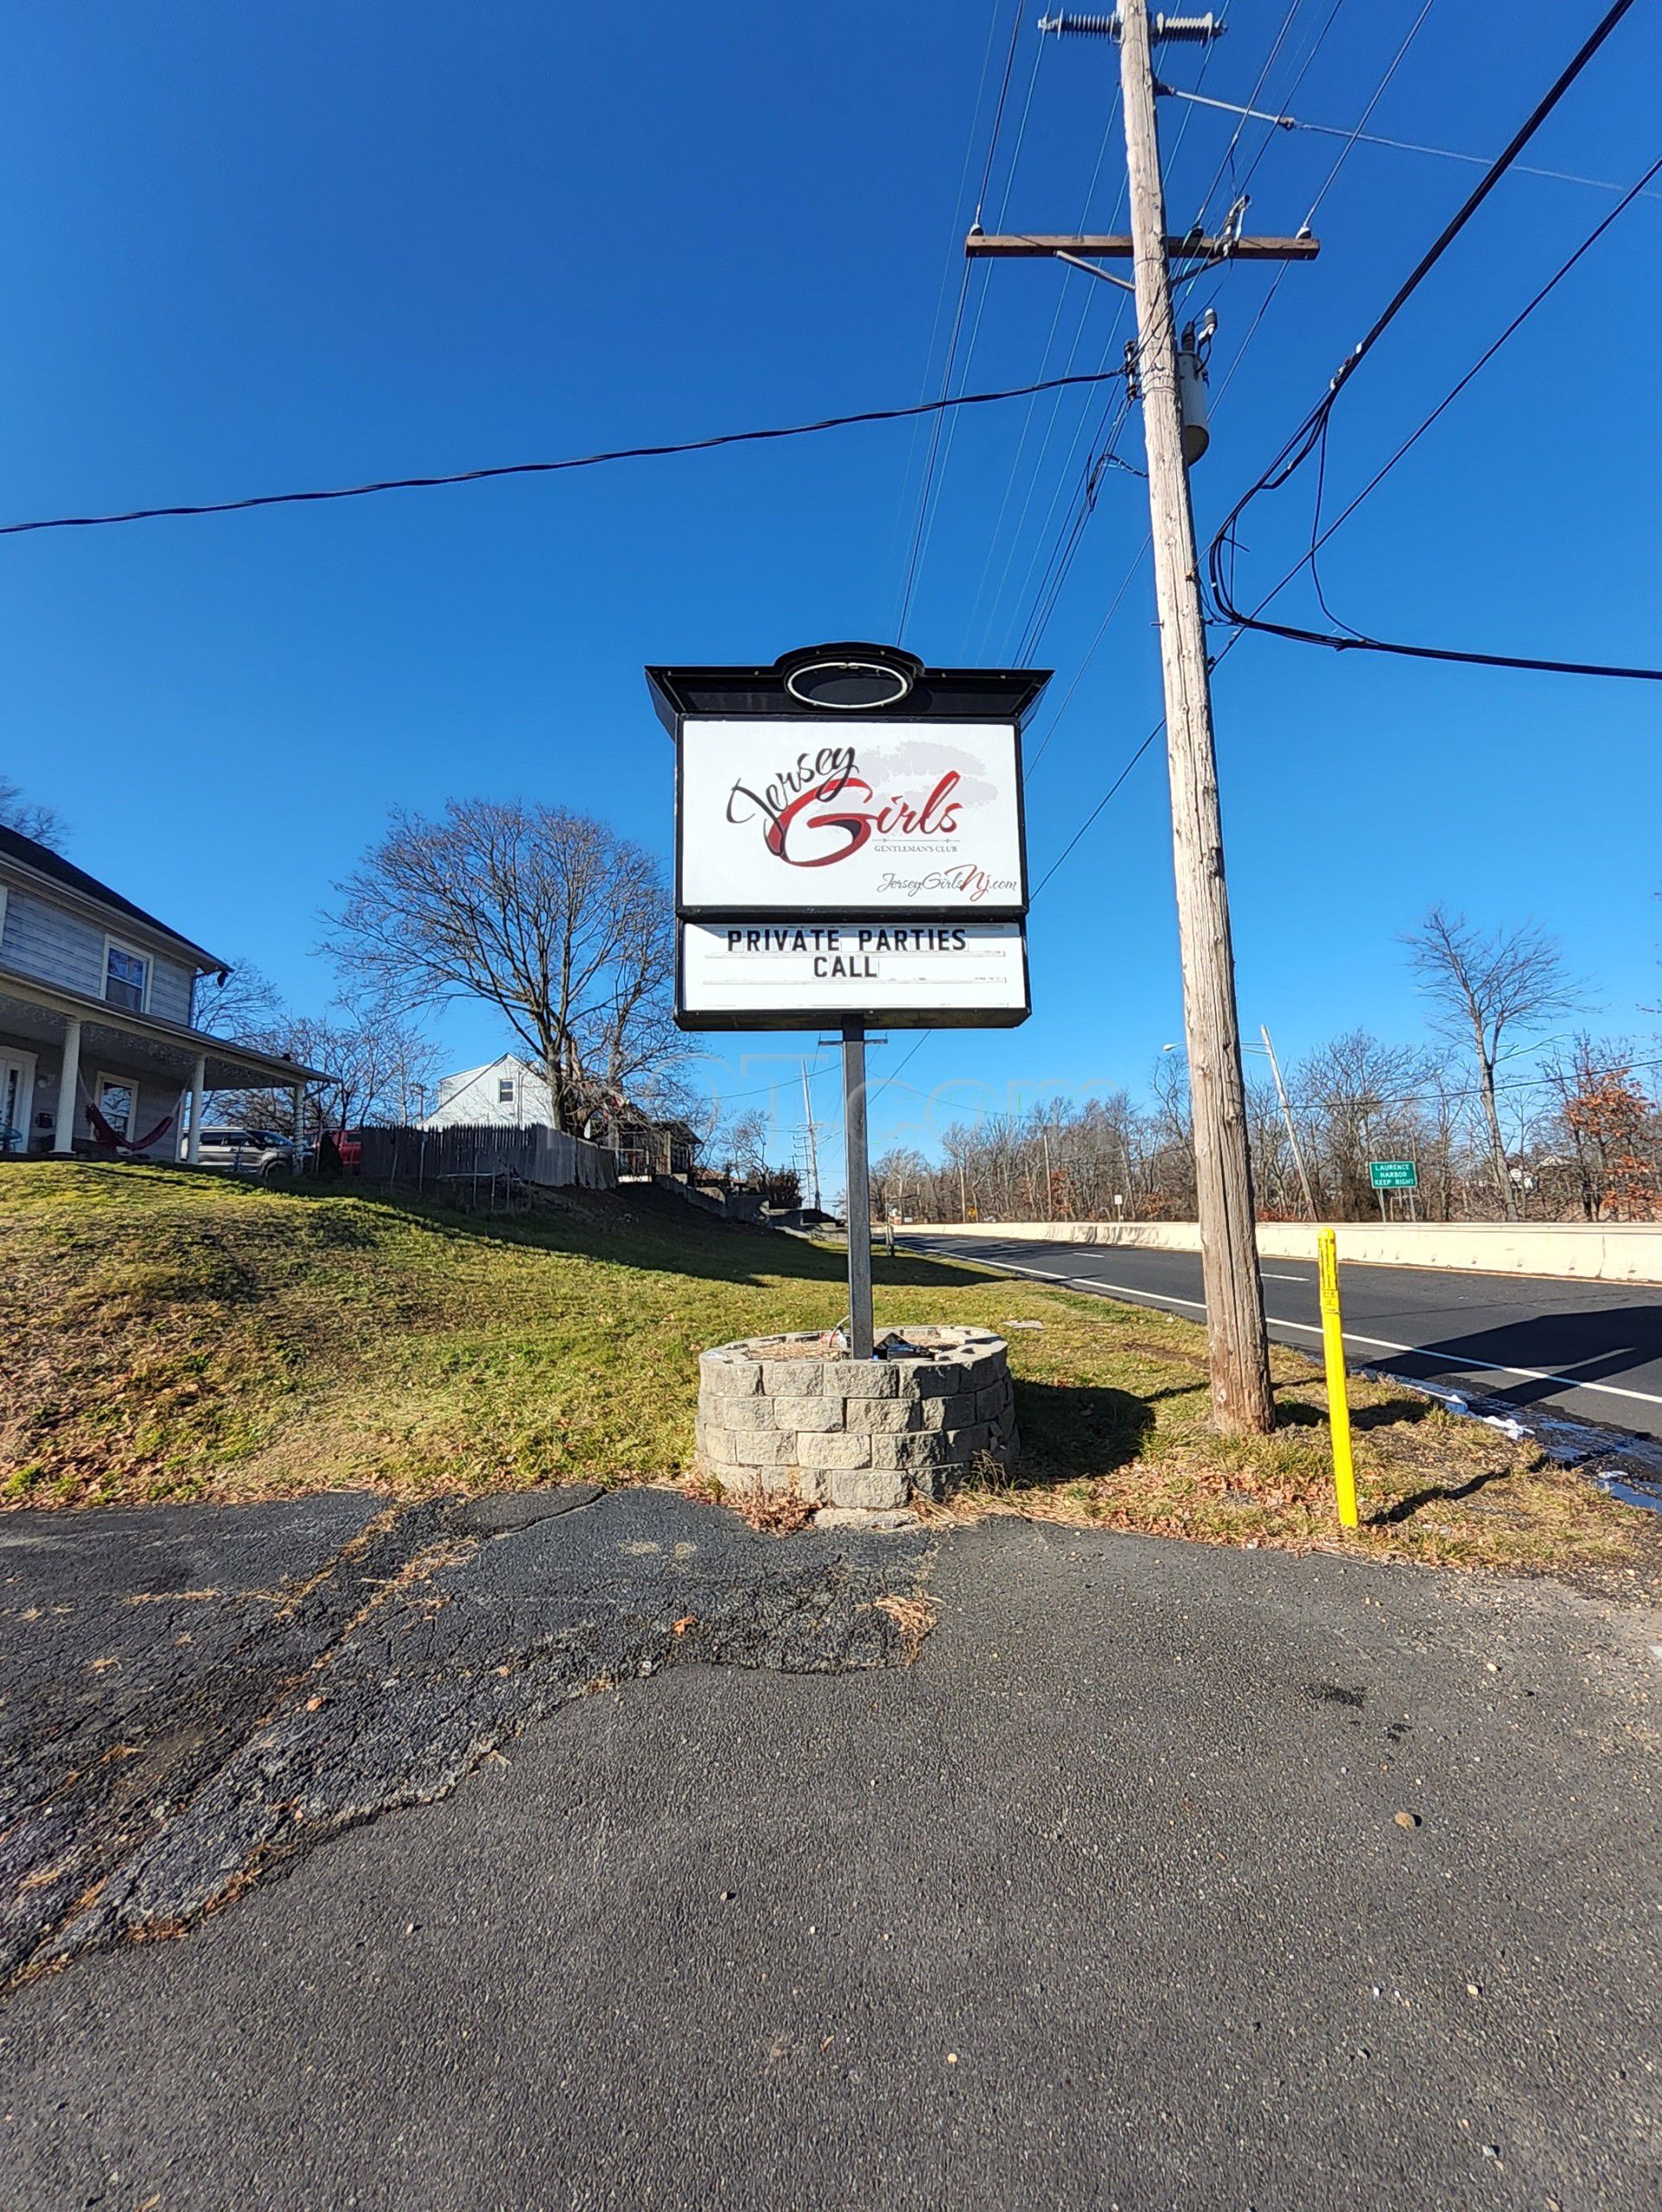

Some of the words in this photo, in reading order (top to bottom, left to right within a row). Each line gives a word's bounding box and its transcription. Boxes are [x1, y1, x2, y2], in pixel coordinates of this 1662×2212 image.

[727, 747, 859, 855] Jersey
[767, 770, 963, 868] Girls
[874, 844, 934, 853] GENTLEMAN'S
[935, 844, 958, 853] CLUB
[727, 929, 840, 951] PRIVATE
[858, 929, 966, 951] PARTIES
[813, 956, 878, 977] CALL
